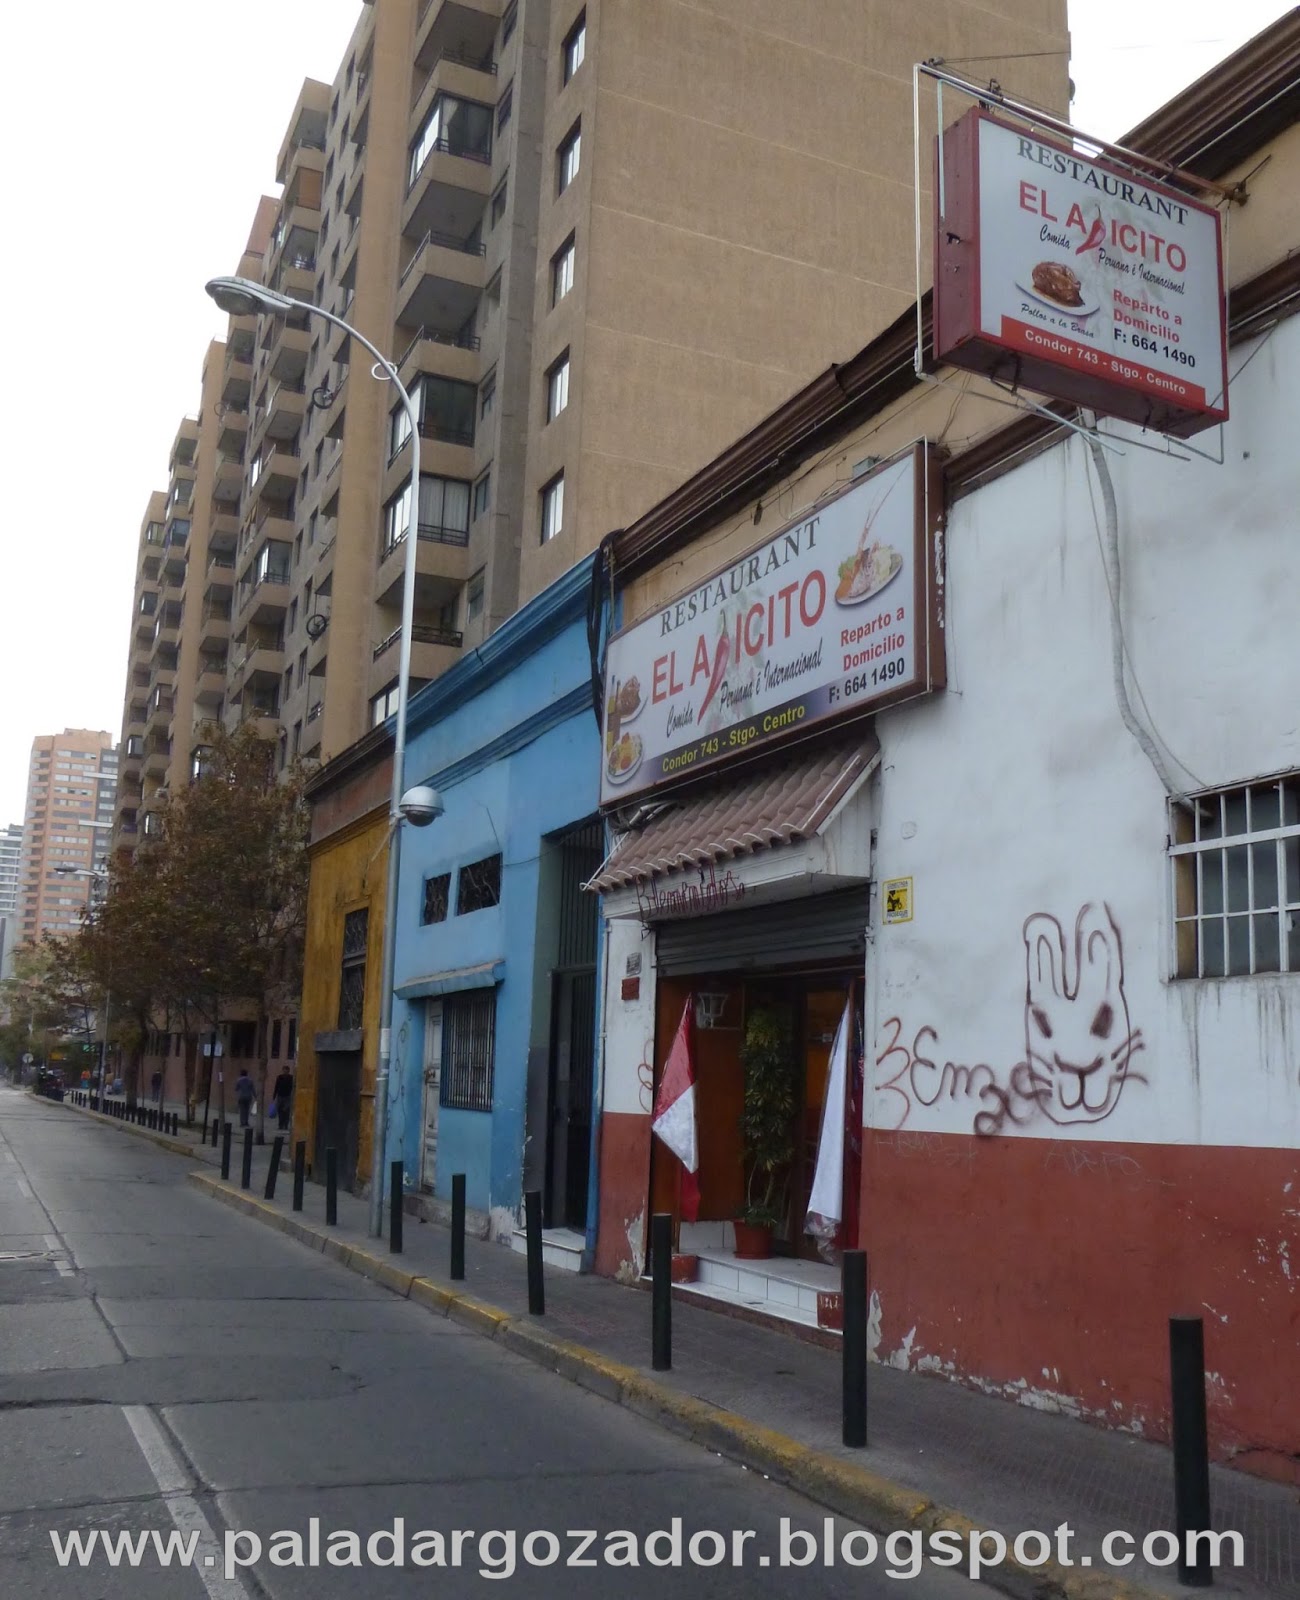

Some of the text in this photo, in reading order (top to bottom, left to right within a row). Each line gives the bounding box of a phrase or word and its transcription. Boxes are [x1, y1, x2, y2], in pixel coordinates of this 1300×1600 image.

[1017, 136, 1189, 225] RESTAURANT
[1019, 180, 1058, 223] EL
[1039, 223, 1071, 250] Comida
[1098, 247, 1130, 274] Peruana
[1138, 265, 1185, 295] Internacional
[1021, 303, 1048, 321] Pollos
[1058, 318, 1067, 328] la
[1071, 322, 1094, 338] Brasa
[1113, 288, 1182, 326] Reparto a
[1113, 308, 1180, 343] Domicilio
[1025, 329, 1073, 355] Condor
[1077, 348, 1099, 364] 743
[1111, 361, 1143, 379] Stgo.
[1146, 372, 1186, 395] Centro
[1114, 328, 1196, 368] F: 664 1490
[660, 517, 820, 638] RESTAURANT
[841, 607, 905, 647] Reparto a
[843, 633, 905, 671] Domicilio
[652, 651, 683, 705] EL
[666, 701, 694, 738] Comida
[720, 680, 753, 712] Peruana
[764, 636, 823, 692] Internacional
[829, 657, 905, 704] F: 664 1490
[662, 749, 698, 772] Condor
[701, 737, 719, 757] 743
[729, 725, 759, 747] Stgo.
[763, 705, 805, 732] Centro
